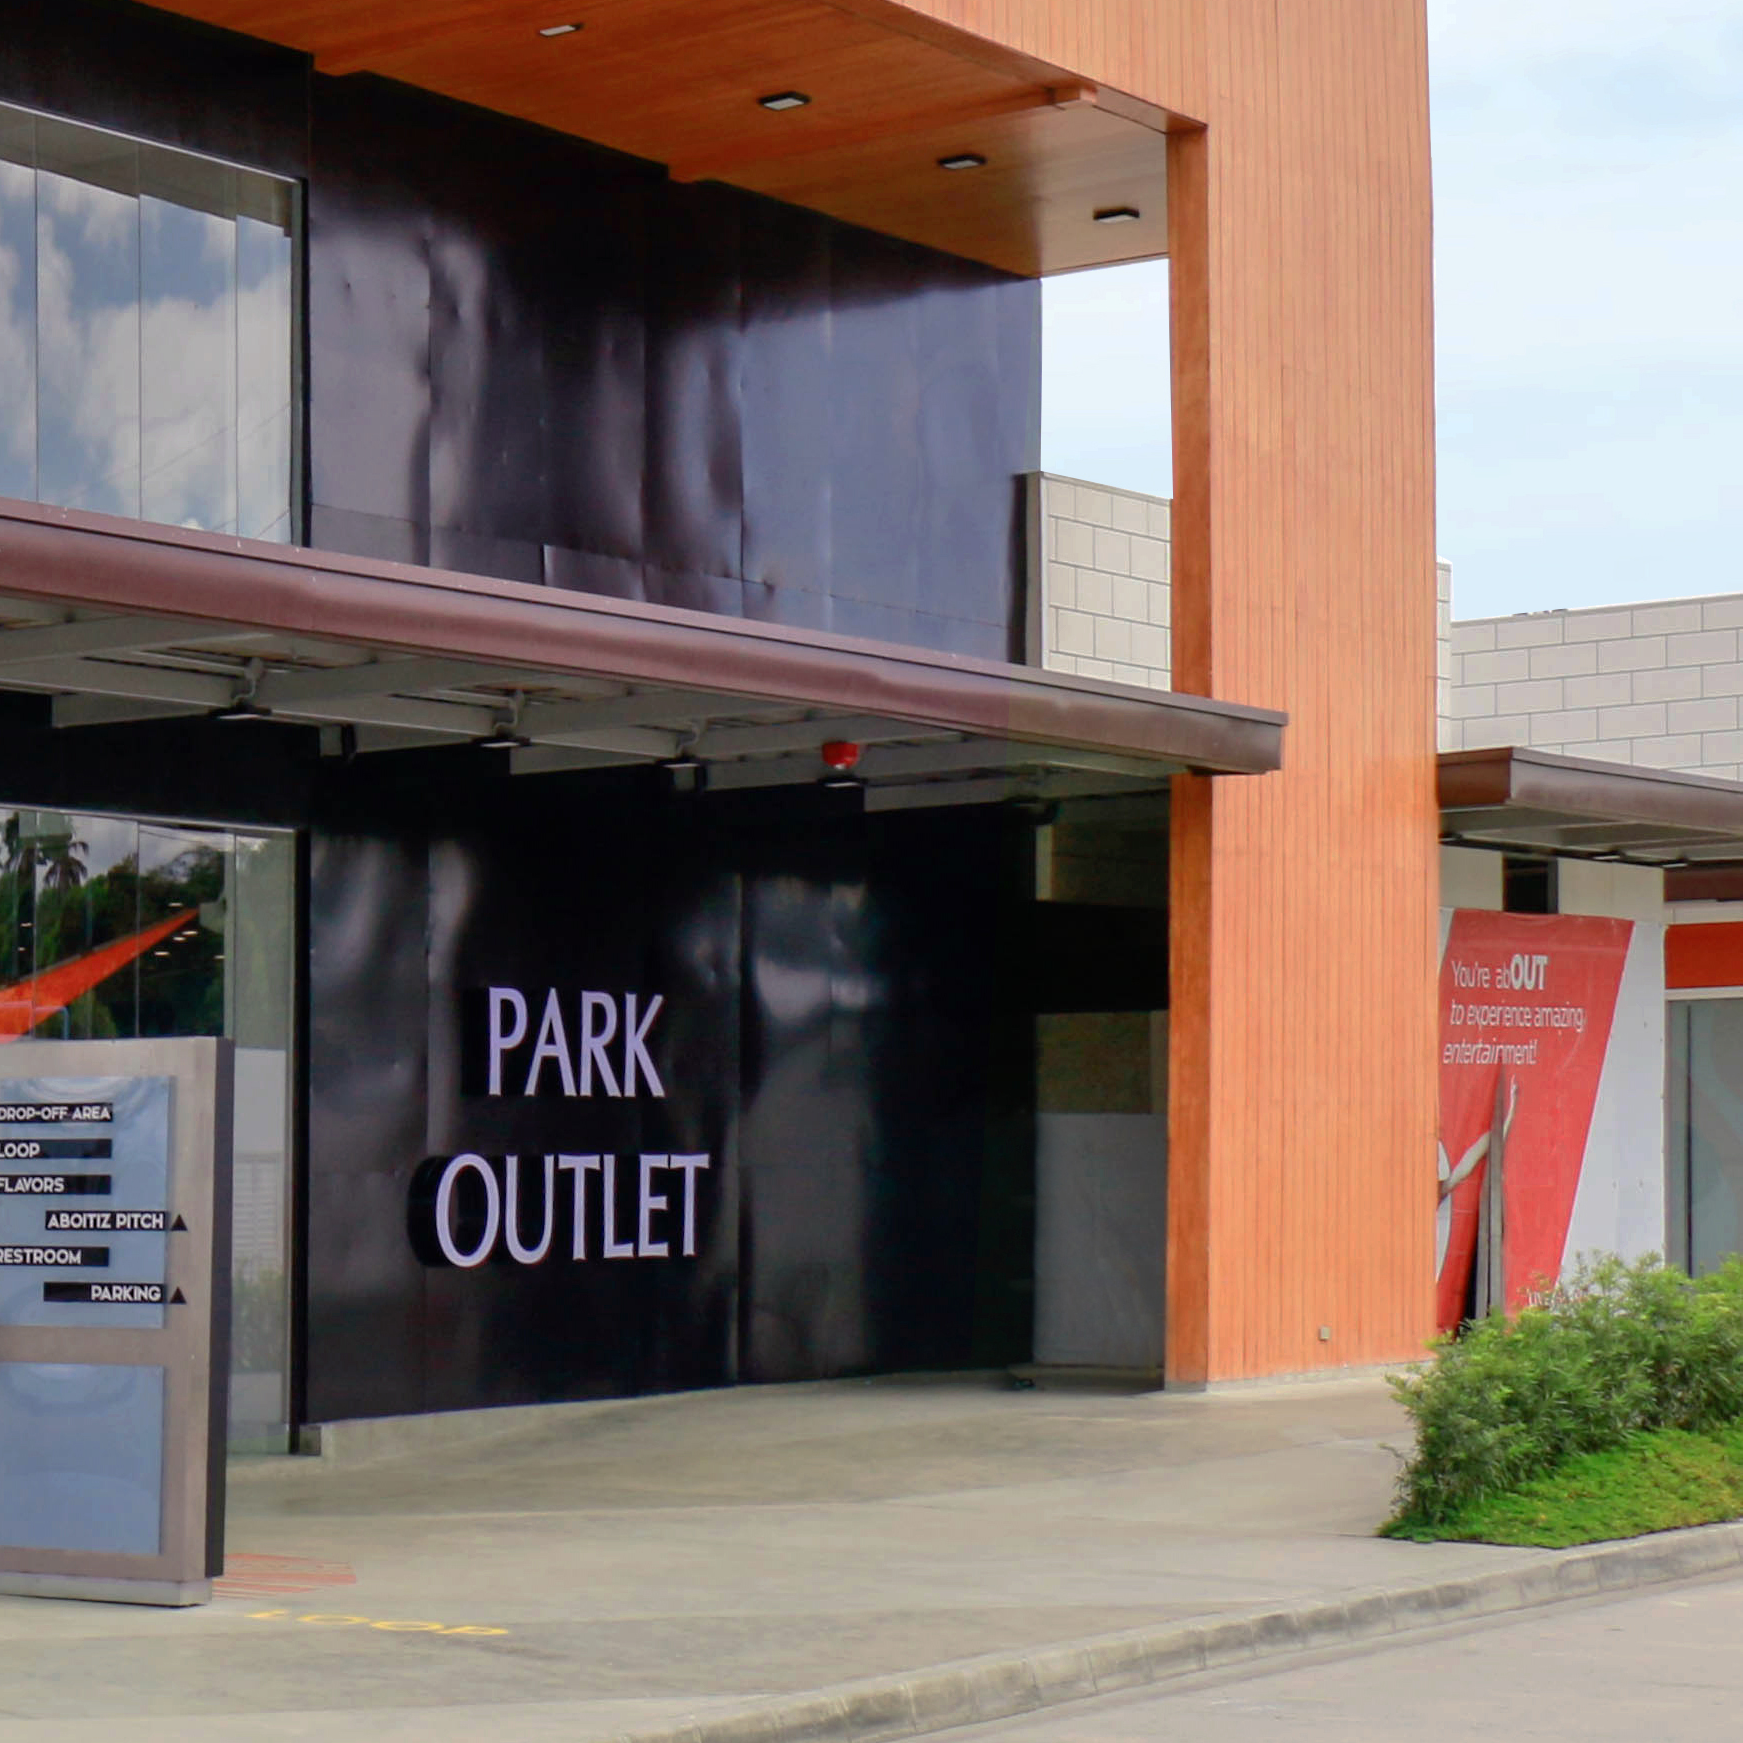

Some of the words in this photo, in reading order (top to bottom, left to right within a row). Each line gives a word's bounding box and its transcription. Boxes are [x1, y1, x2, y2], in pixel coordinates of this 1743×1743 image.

[1451, 960, 1491, 988] You're
[1496, 954, 1549, 990] abOUT
[1450, 999, 1465, 1025] to
[1467, 1000, 1532, 1031] experience
[1533, 1001, 1586, 1033] amazing
[488, 986, 665, 1098] PARK
[1443, 1037, 1539, 1065] entertainment!
[71, 1106, 112, 1121] AREA
[47, 1213, 111, 1229] ABOITIZ
[115, 1213, 164, 1229] PITCH
[435, 1153, 710, 1268] OUTLET
[90, 1285, 161, 1302] PARKING
